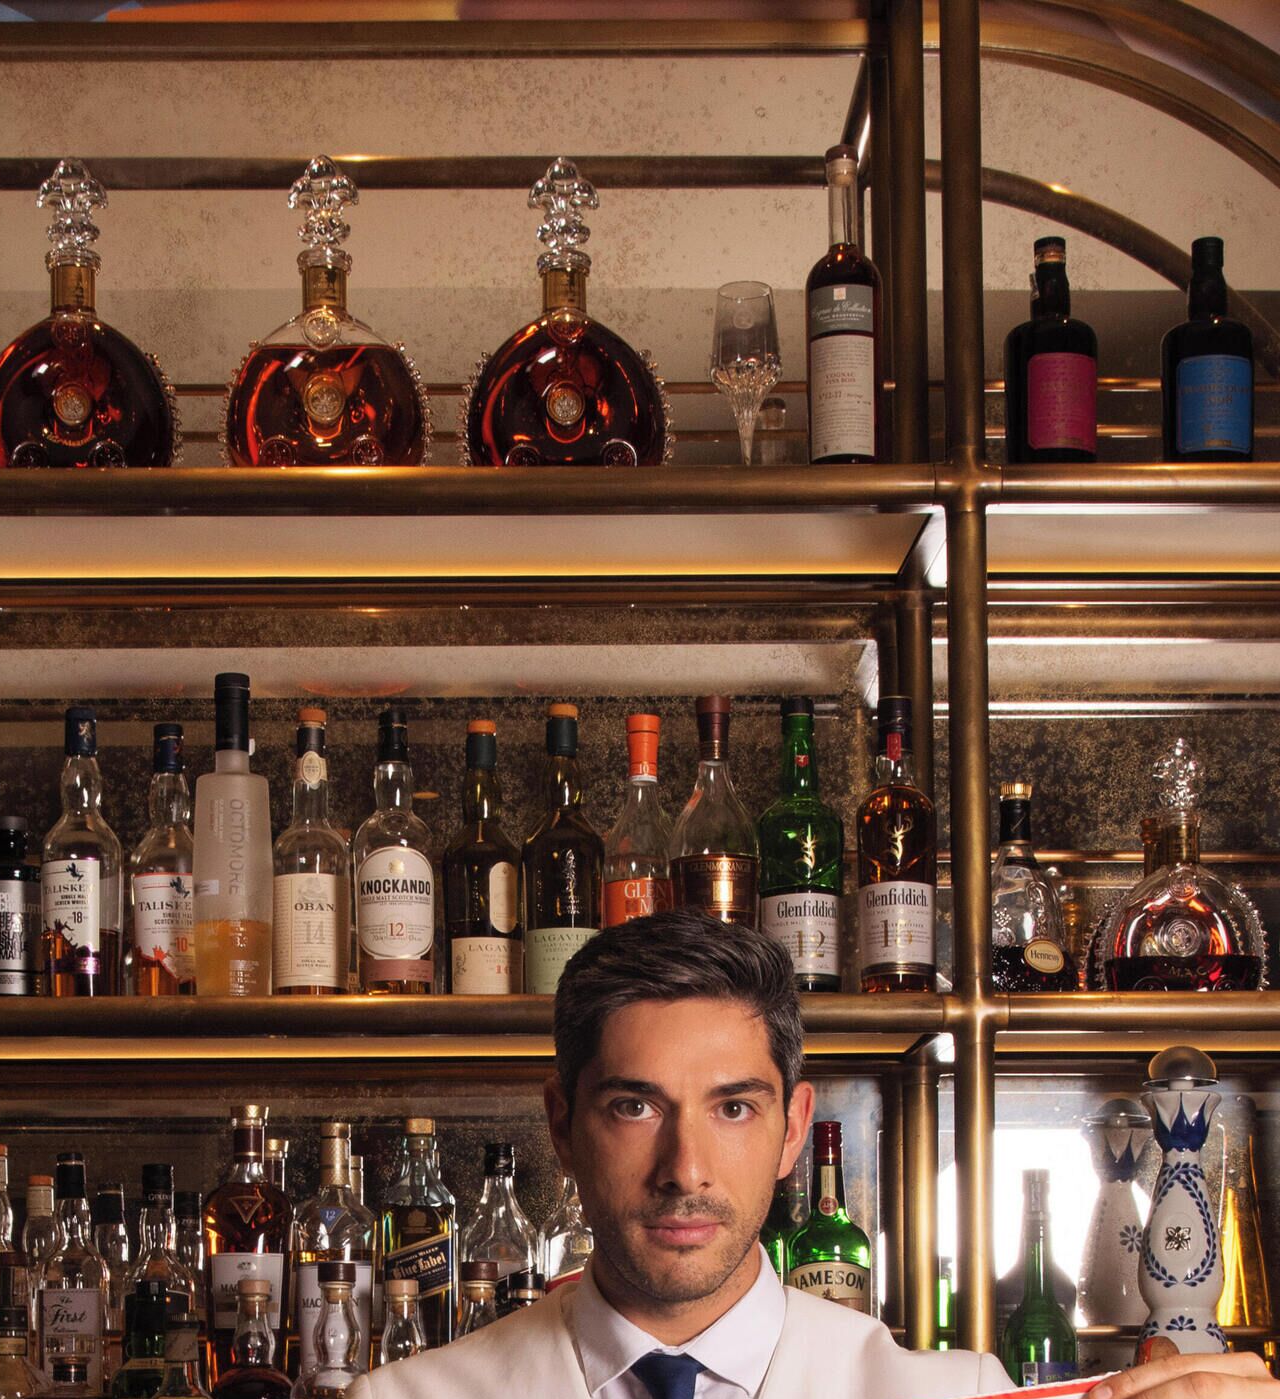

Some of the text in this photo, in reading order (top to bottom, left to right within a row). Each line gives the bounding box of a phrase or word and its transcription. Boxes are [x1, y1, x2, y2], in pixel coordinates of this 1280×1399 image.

[639, 764, 649, 774] 10
[229, 798, 244, 896] OCTOMORE
[360, 879, 431, 896] KNOCKANDO
[624, 882, 666, 898] GLEN
[72, 912, 83, 923] 18
[303, 921, 326, 945] 14
[388, 923, 404, 936] 12
[881, 919, 913, 948] 15
[175, 938, 188, 952] 10
[793, 930, 825, 958] 12
[1030, 950, 1060, 963] Hennessy
[325, 1211, 336, 1219] 12
[392, 1252, 446, 1279] Blue Label
[795, 1270, 864, 1290] JAMESON
[50, 1304, 86, 1326] First
